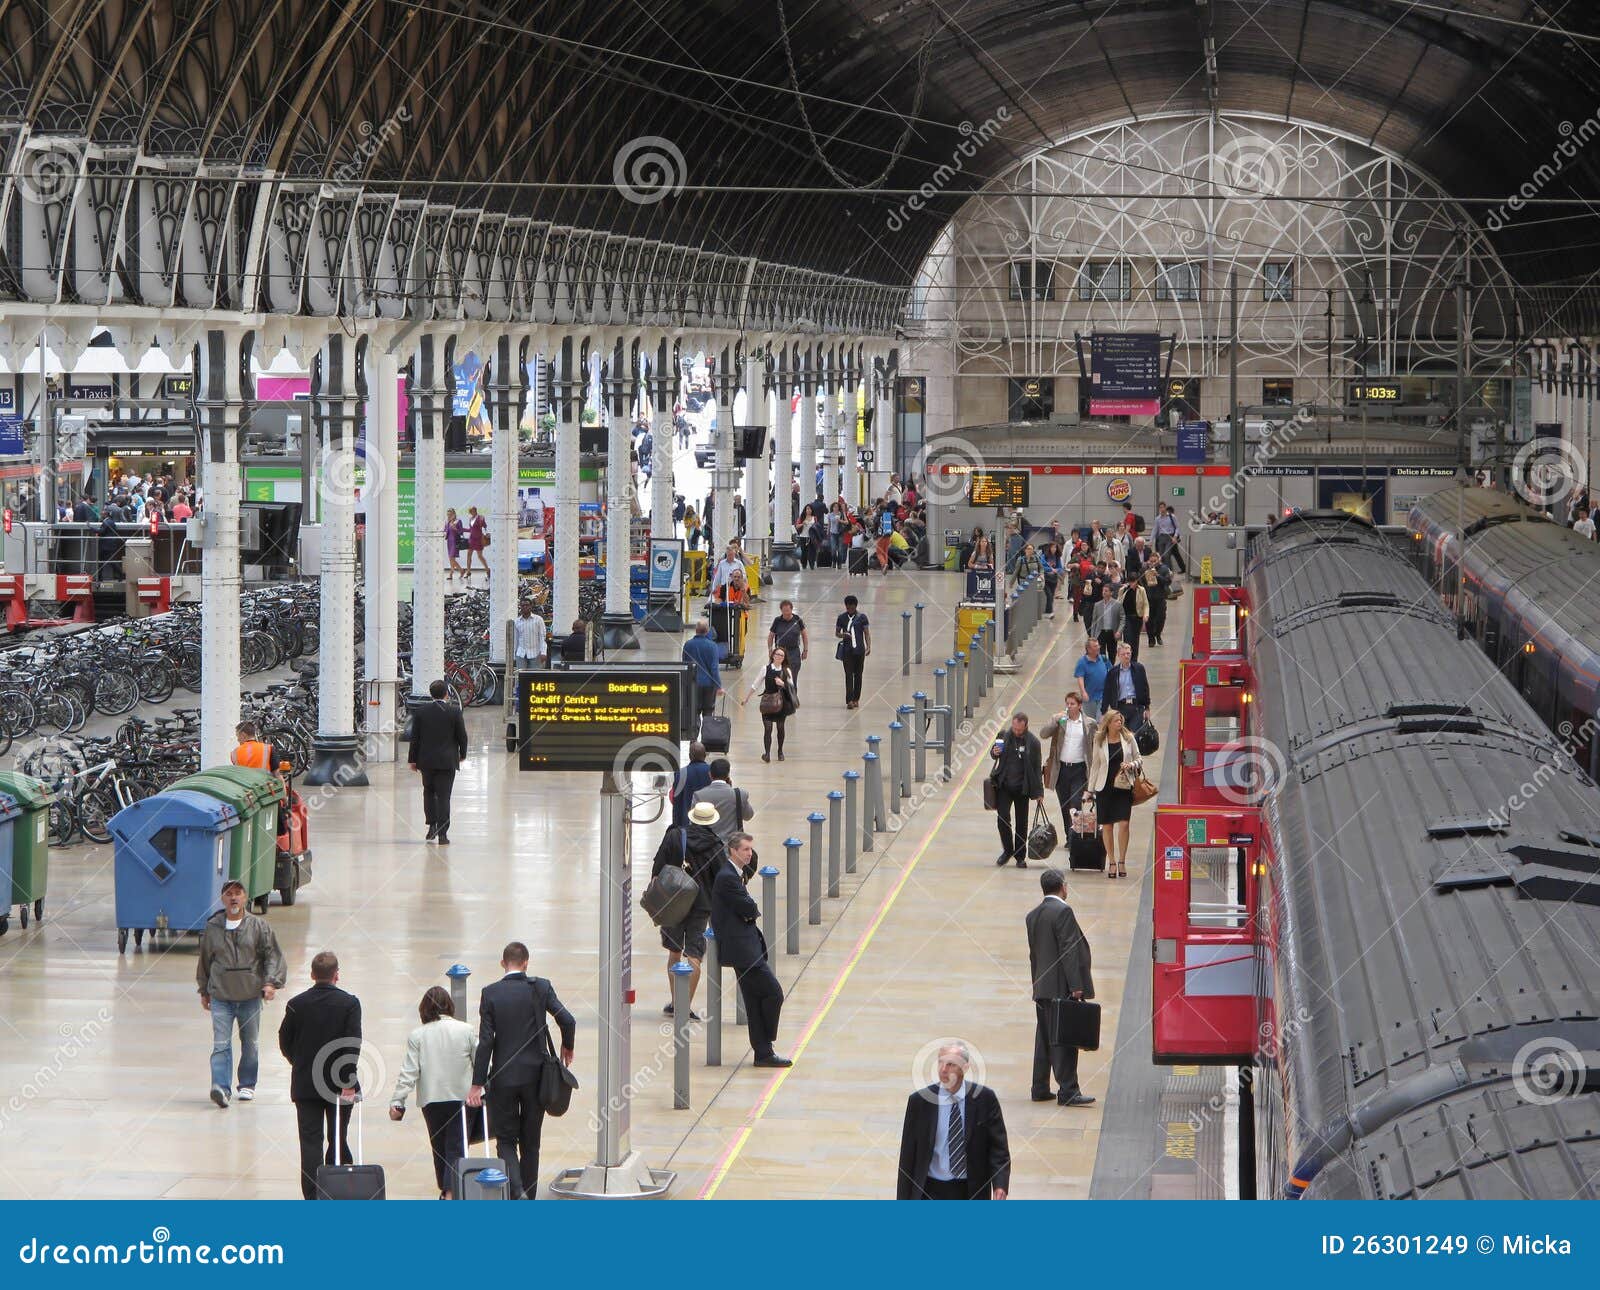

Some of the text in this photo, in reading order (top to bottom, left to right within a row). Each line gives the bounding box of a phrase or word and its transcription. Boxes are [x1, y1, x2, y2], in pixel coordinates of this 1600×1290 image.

[0, 392, 11, 404] 13
[82, 388, 108, 399] Taxis
[520, 470, 556, 479] Whistlesto
[1092, 466, 1147, 475] BURGER KING
[1276, 467, 1284, 475] de
[1285, 467, 1309, 475] France
[1420, 468, 1429, 476] de
[1431, 468, 1454, 476] France
[1110, 487, 1130, 497] KING
[530, 683, 648, 694] 14:15 Boarding
[530, 695, 598, 704] Cardiff Central
